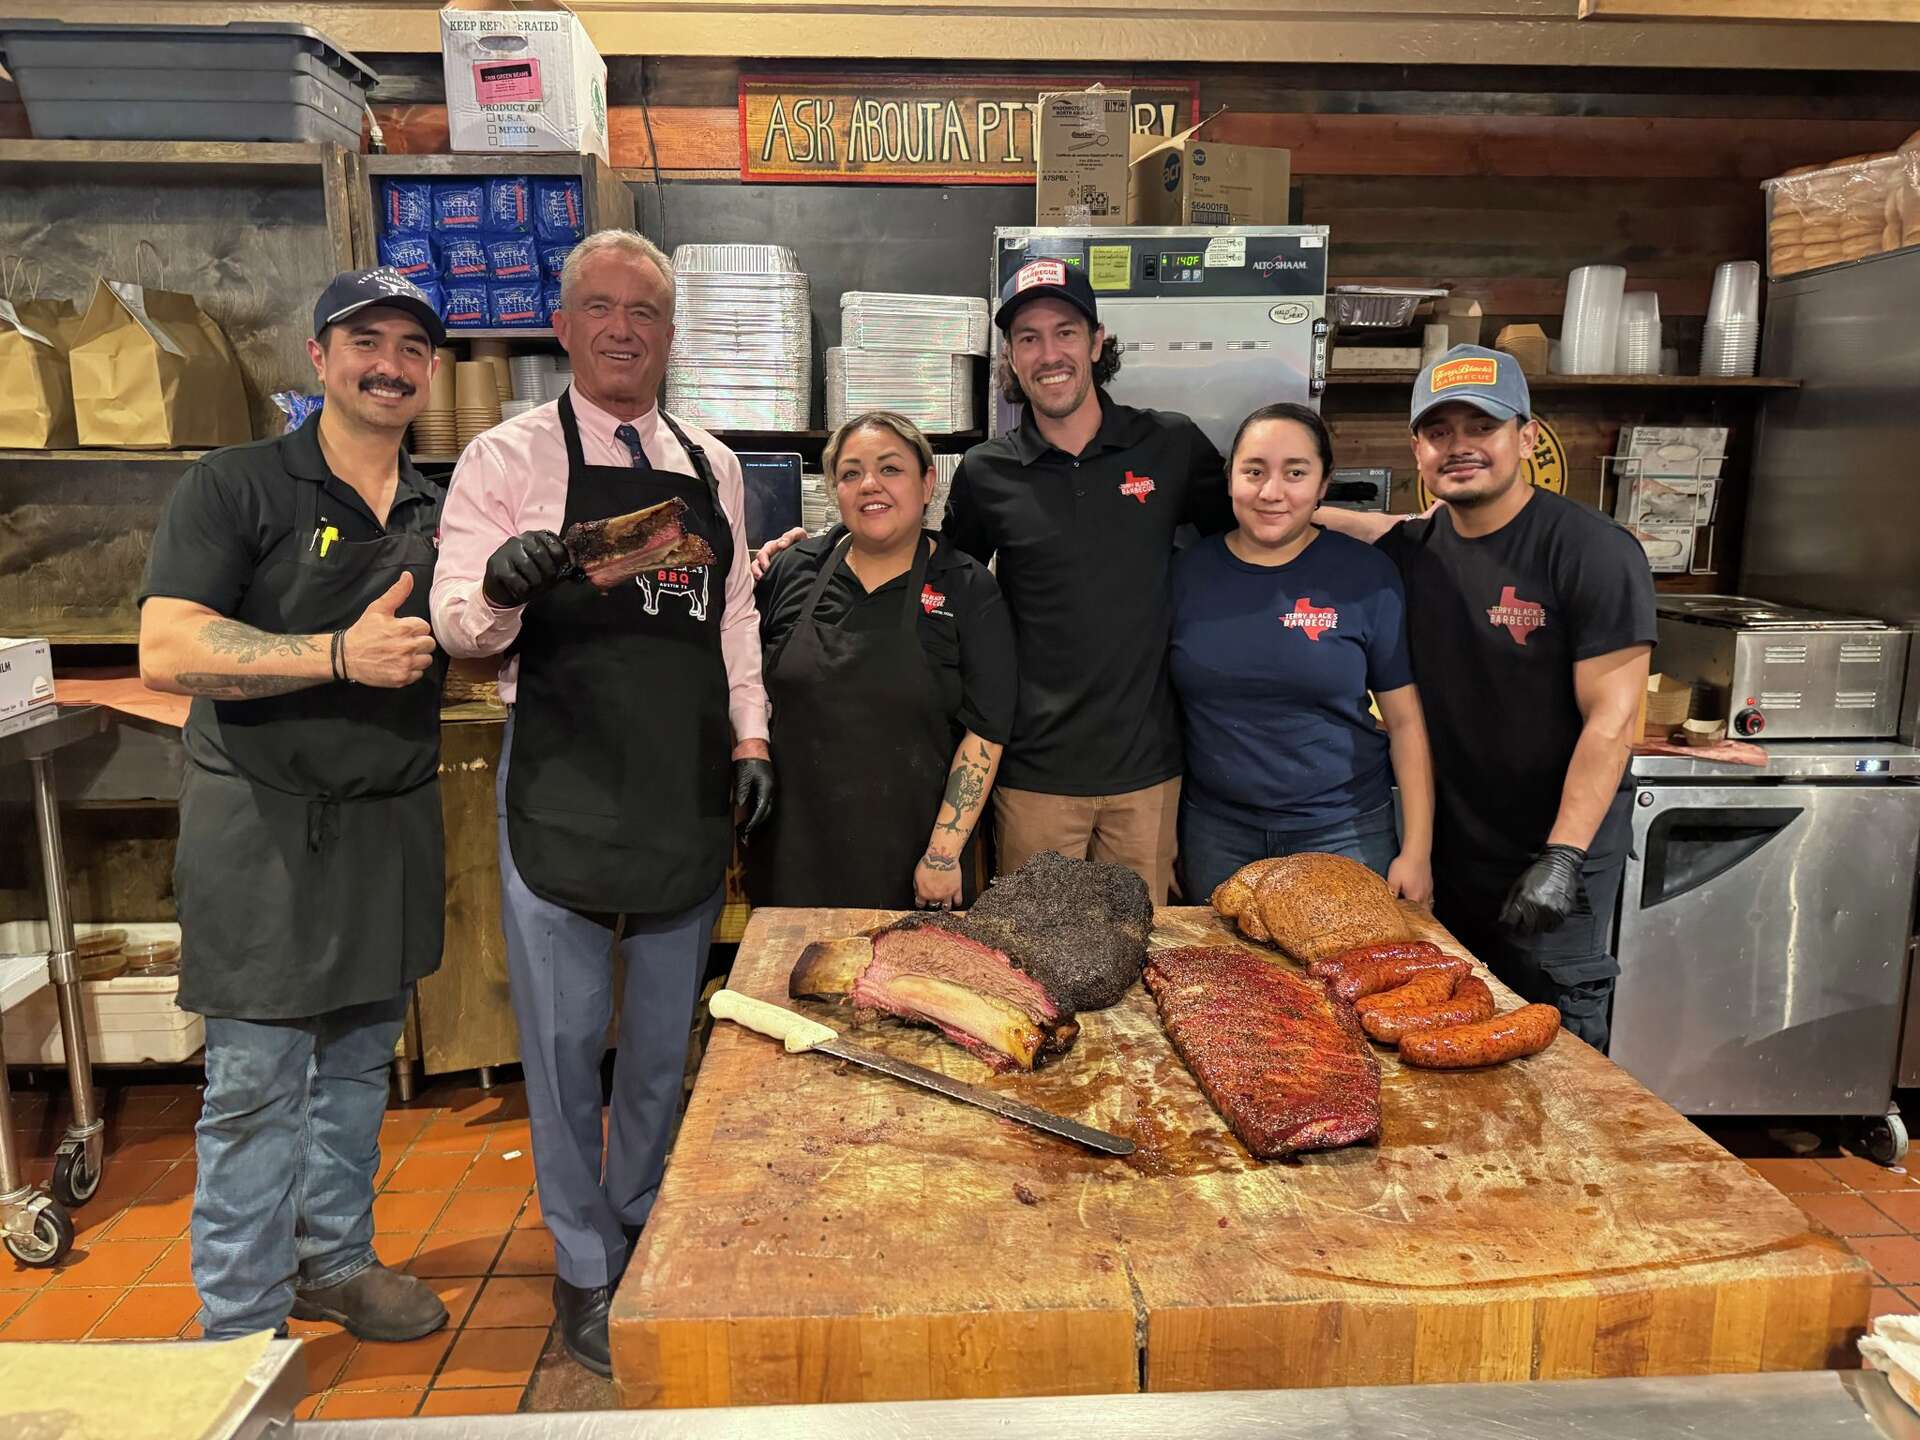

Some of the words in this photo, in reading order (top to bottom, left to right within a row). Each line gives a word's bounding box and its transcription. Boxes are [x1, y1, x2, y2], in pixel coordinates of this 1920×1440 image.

[450, 20, 477, 32] KEEP
[479, 20, 559, 32] REFERATED
[480, 103, 524, 113] PRODUCT
[527, 103, 541, 113] OF
[497, 113, 526, 123] U.S.A.
[498, 126, 536, 134] MEXICO
[761, 95, 836, 163] ASK
[1192, 173, 1211, 182] Tongs
[442, 200, 478, 208] EXTRA
[442, 207, 477, 218] THIN
[450, 249, 484, 259] EXTRA
[493, 249, 529, 260] EXTRA
[548, 255, 567, 264] EXT
[452, 256, 487, 267] THIN
[495, 257, 529, 269] THIN
[1175, 256, 1200, 267] 140F
[498, 296, 534, 305] EXTRA
[500, 303, 534, 314] THIN
[1436, 374, 1491, 388] BARBECUE
[657, 570, 690, 584] BBQ
[1491, 605, 1512, 615] TERRY
[1284, 612, 1308, 621] TERRY
[1489, 614, 1547, 627] BARBECUE
[1283, 618, 1339, 629] BARBECUE
